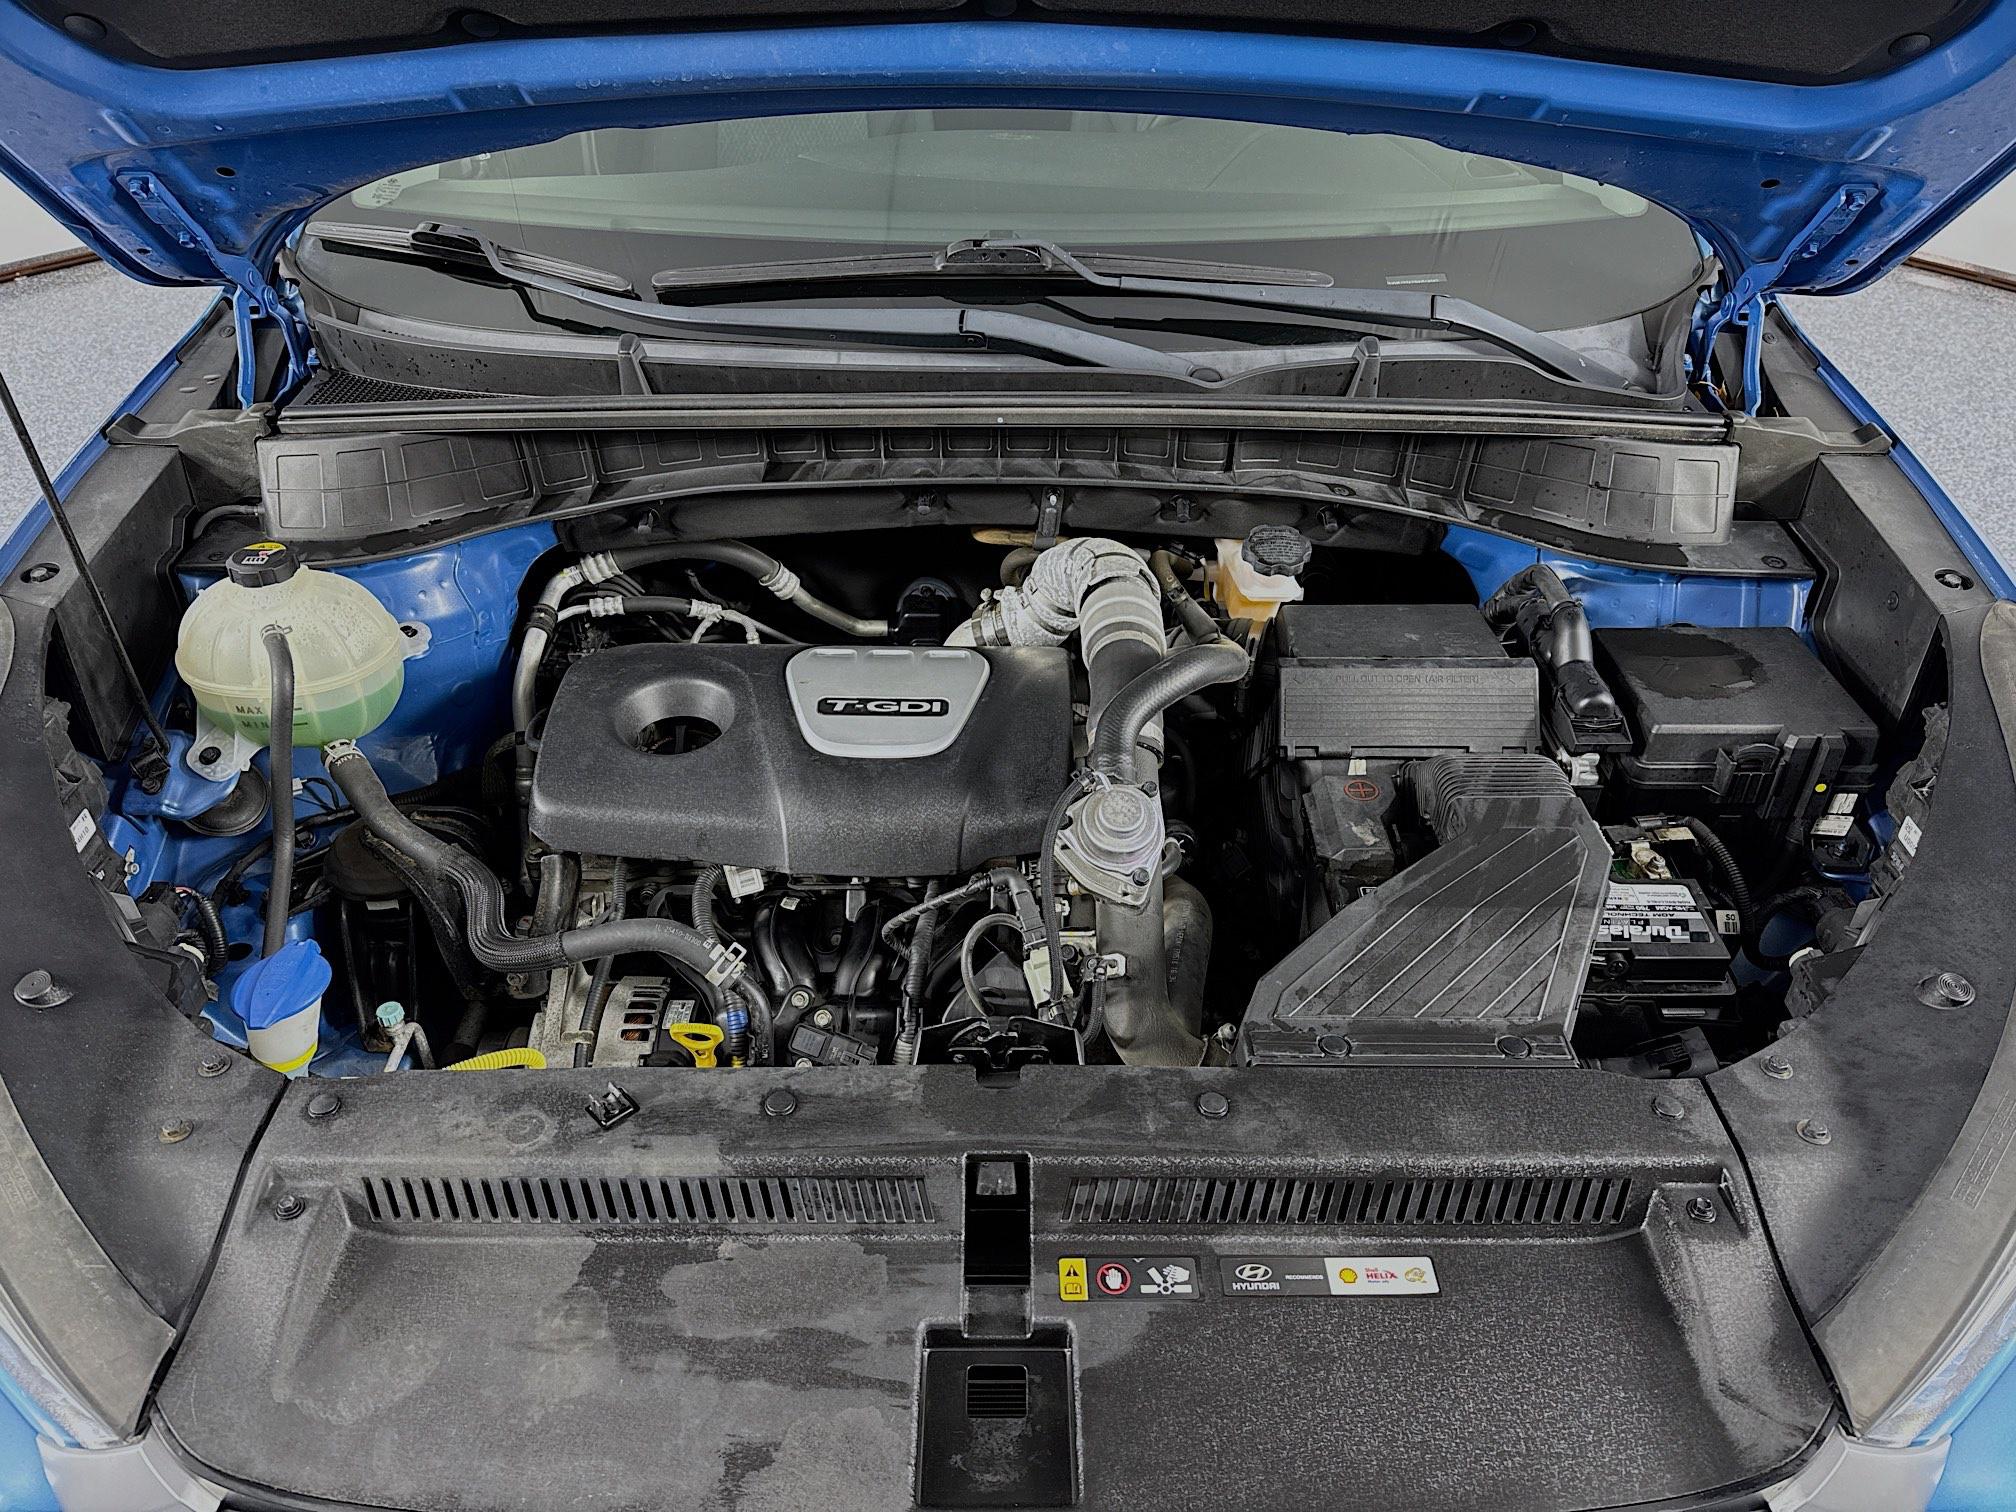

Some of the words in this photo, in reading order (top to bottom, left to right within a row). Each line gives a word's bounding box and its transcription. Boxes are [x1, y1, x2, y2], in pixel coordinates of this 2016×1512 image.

[1335, 674, 1360, 683] PULL
[1361, 674, 1378, 683] OUT
[1381, 674, 1394, 683] TO
[1397, 674, 1421, 683] OPEN
[235, 705, 263, 715] MAX
[826, 699, 942, 713] T-GDI
[241, 720, 270, 729] MIN
[334, 753, 362, 768] TANK
[1366, 1270, 1399, 1280] HELIX
[1232, 1282, 1280, 1290] HYUNDAI
